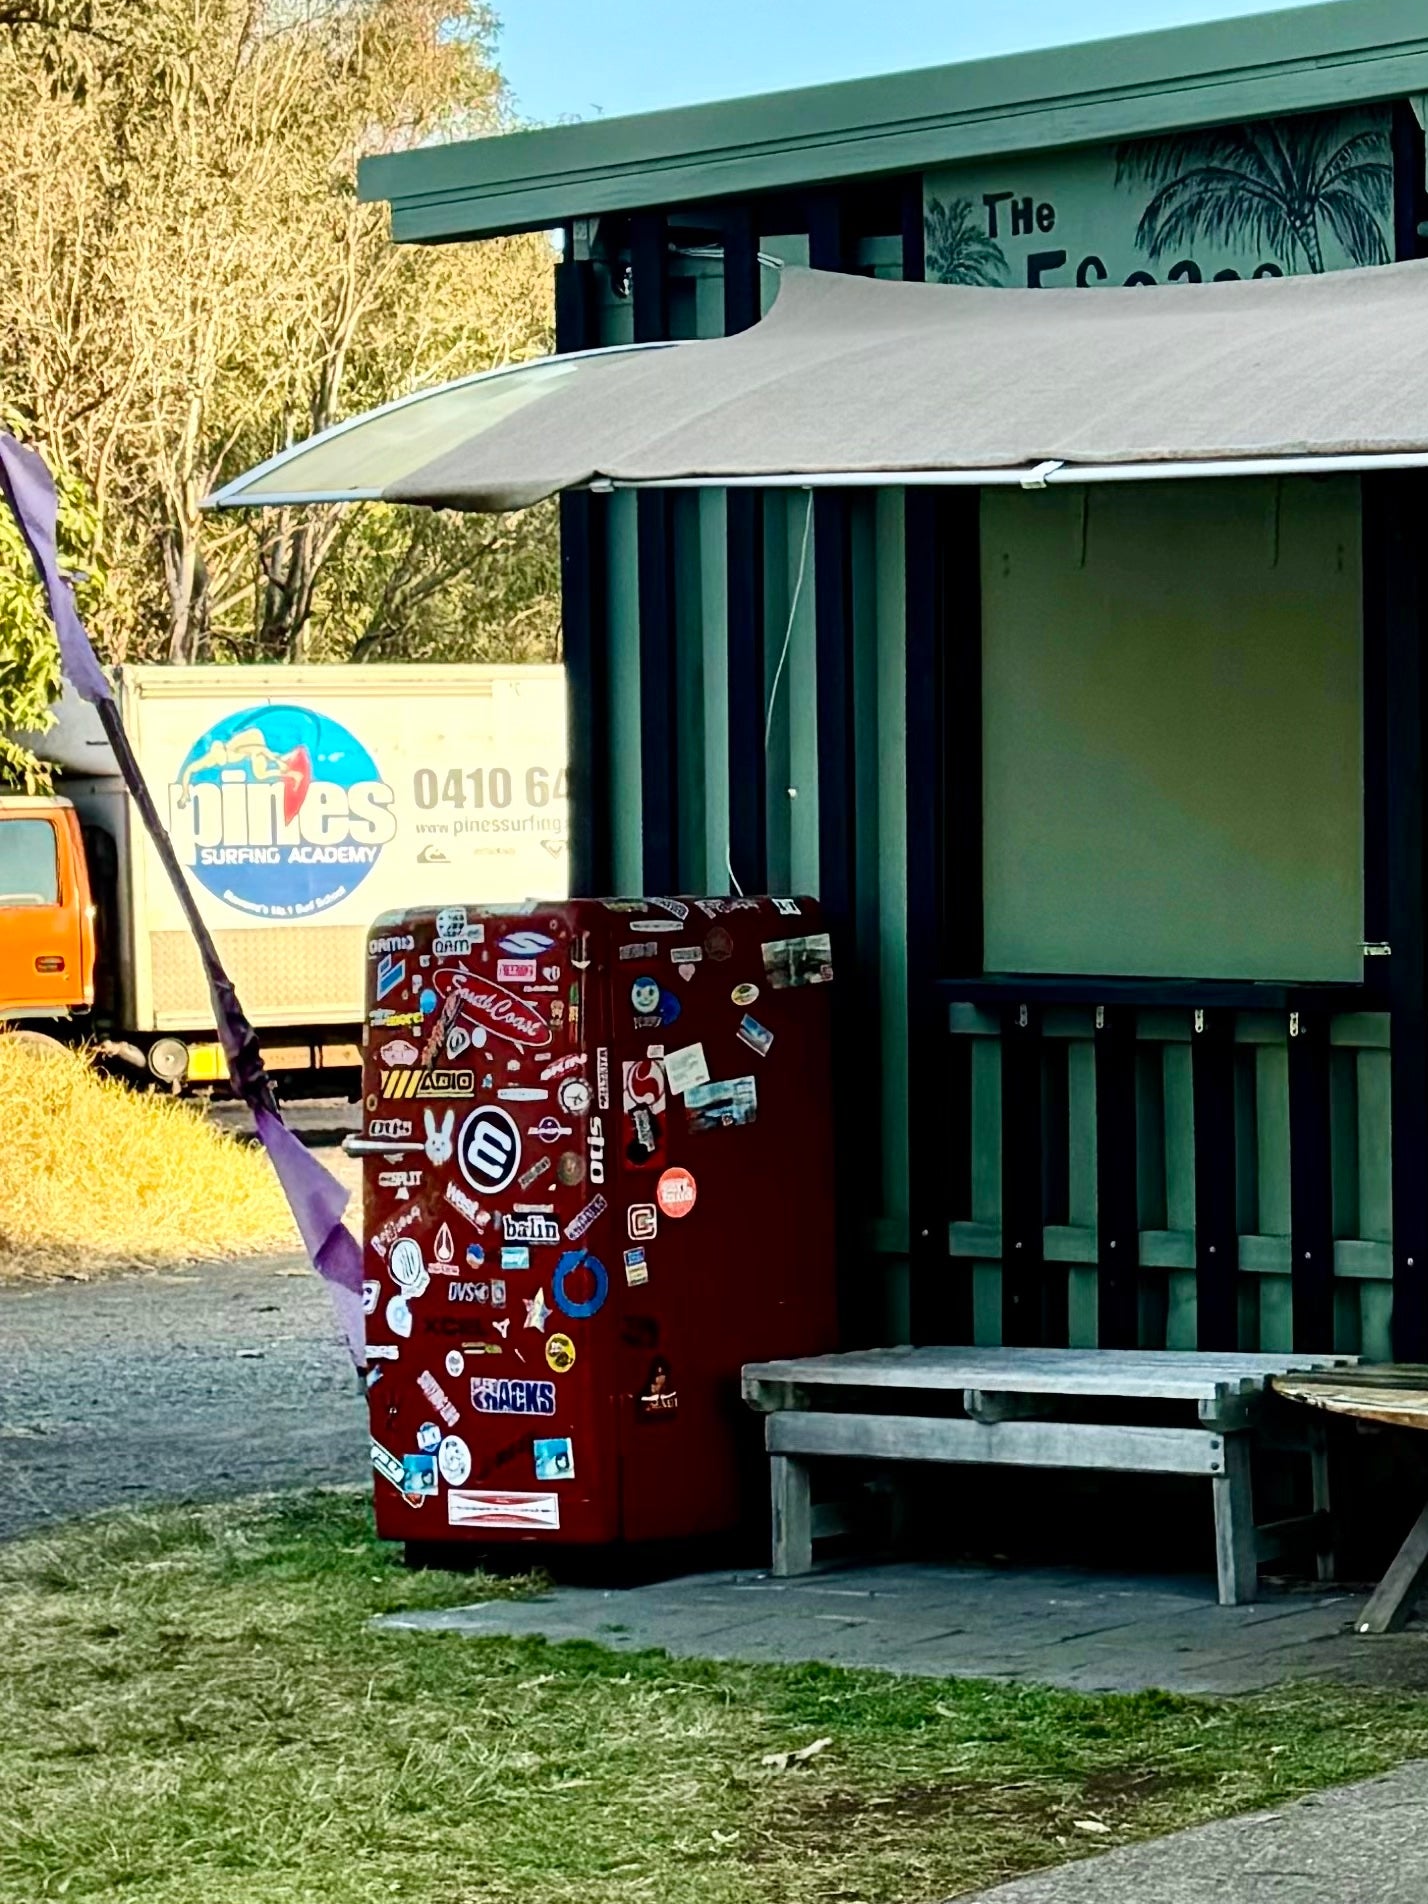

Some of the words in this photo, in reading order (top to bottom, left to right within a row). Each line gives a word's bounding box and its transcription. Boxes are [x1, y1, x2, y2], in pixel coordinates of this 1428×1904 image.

[413, 767, 512, 810] 0410
[168, 769, 398, 866] pines
[201, 847, 280, 866] SURFING
[288, 846, 378, 865] ACADEMY
